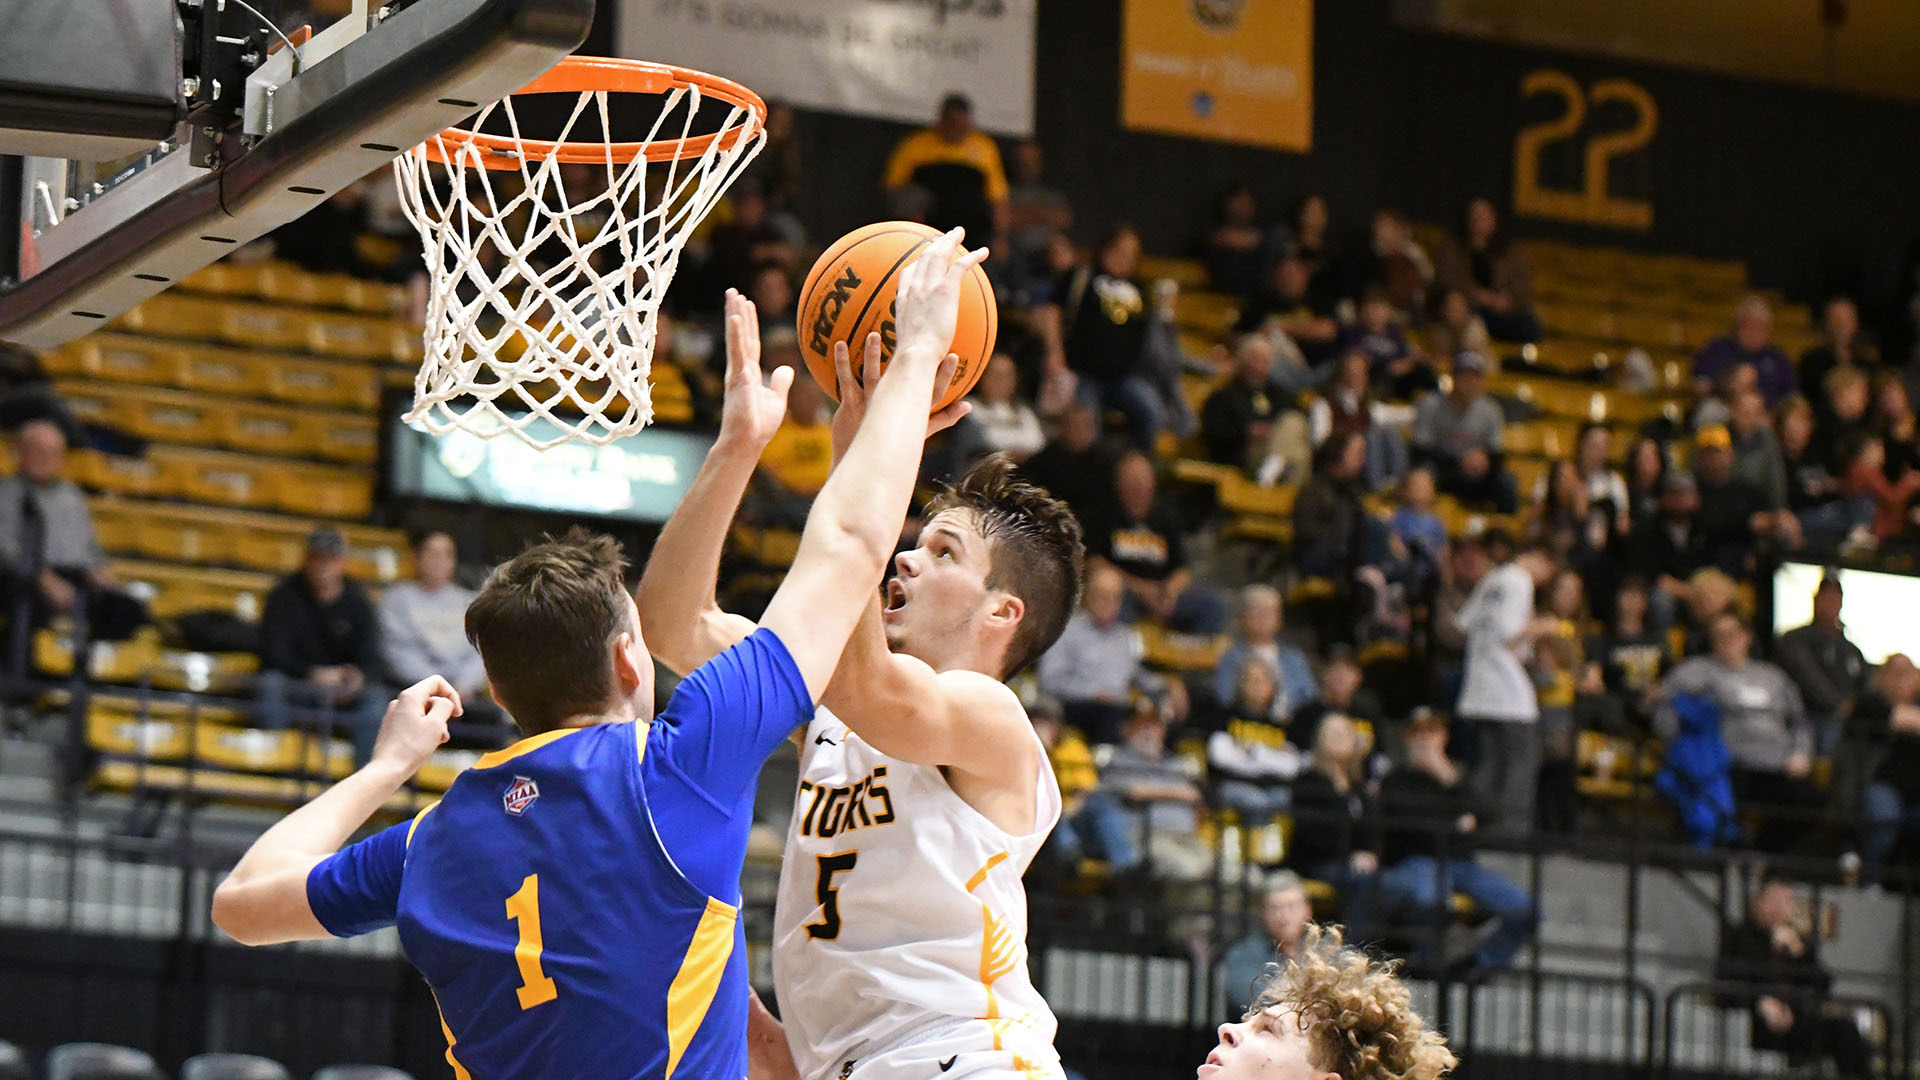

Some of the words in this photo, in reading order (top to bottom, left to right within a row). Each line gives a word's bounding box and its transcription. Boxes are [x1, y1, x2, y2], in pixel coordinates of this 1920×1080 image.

[1514, 69, 1659, 230] 22
[810, 266, 862, 358] NCAA
[505, 873, 558, 1011] 1
[802, 849, 858, 942] 5
